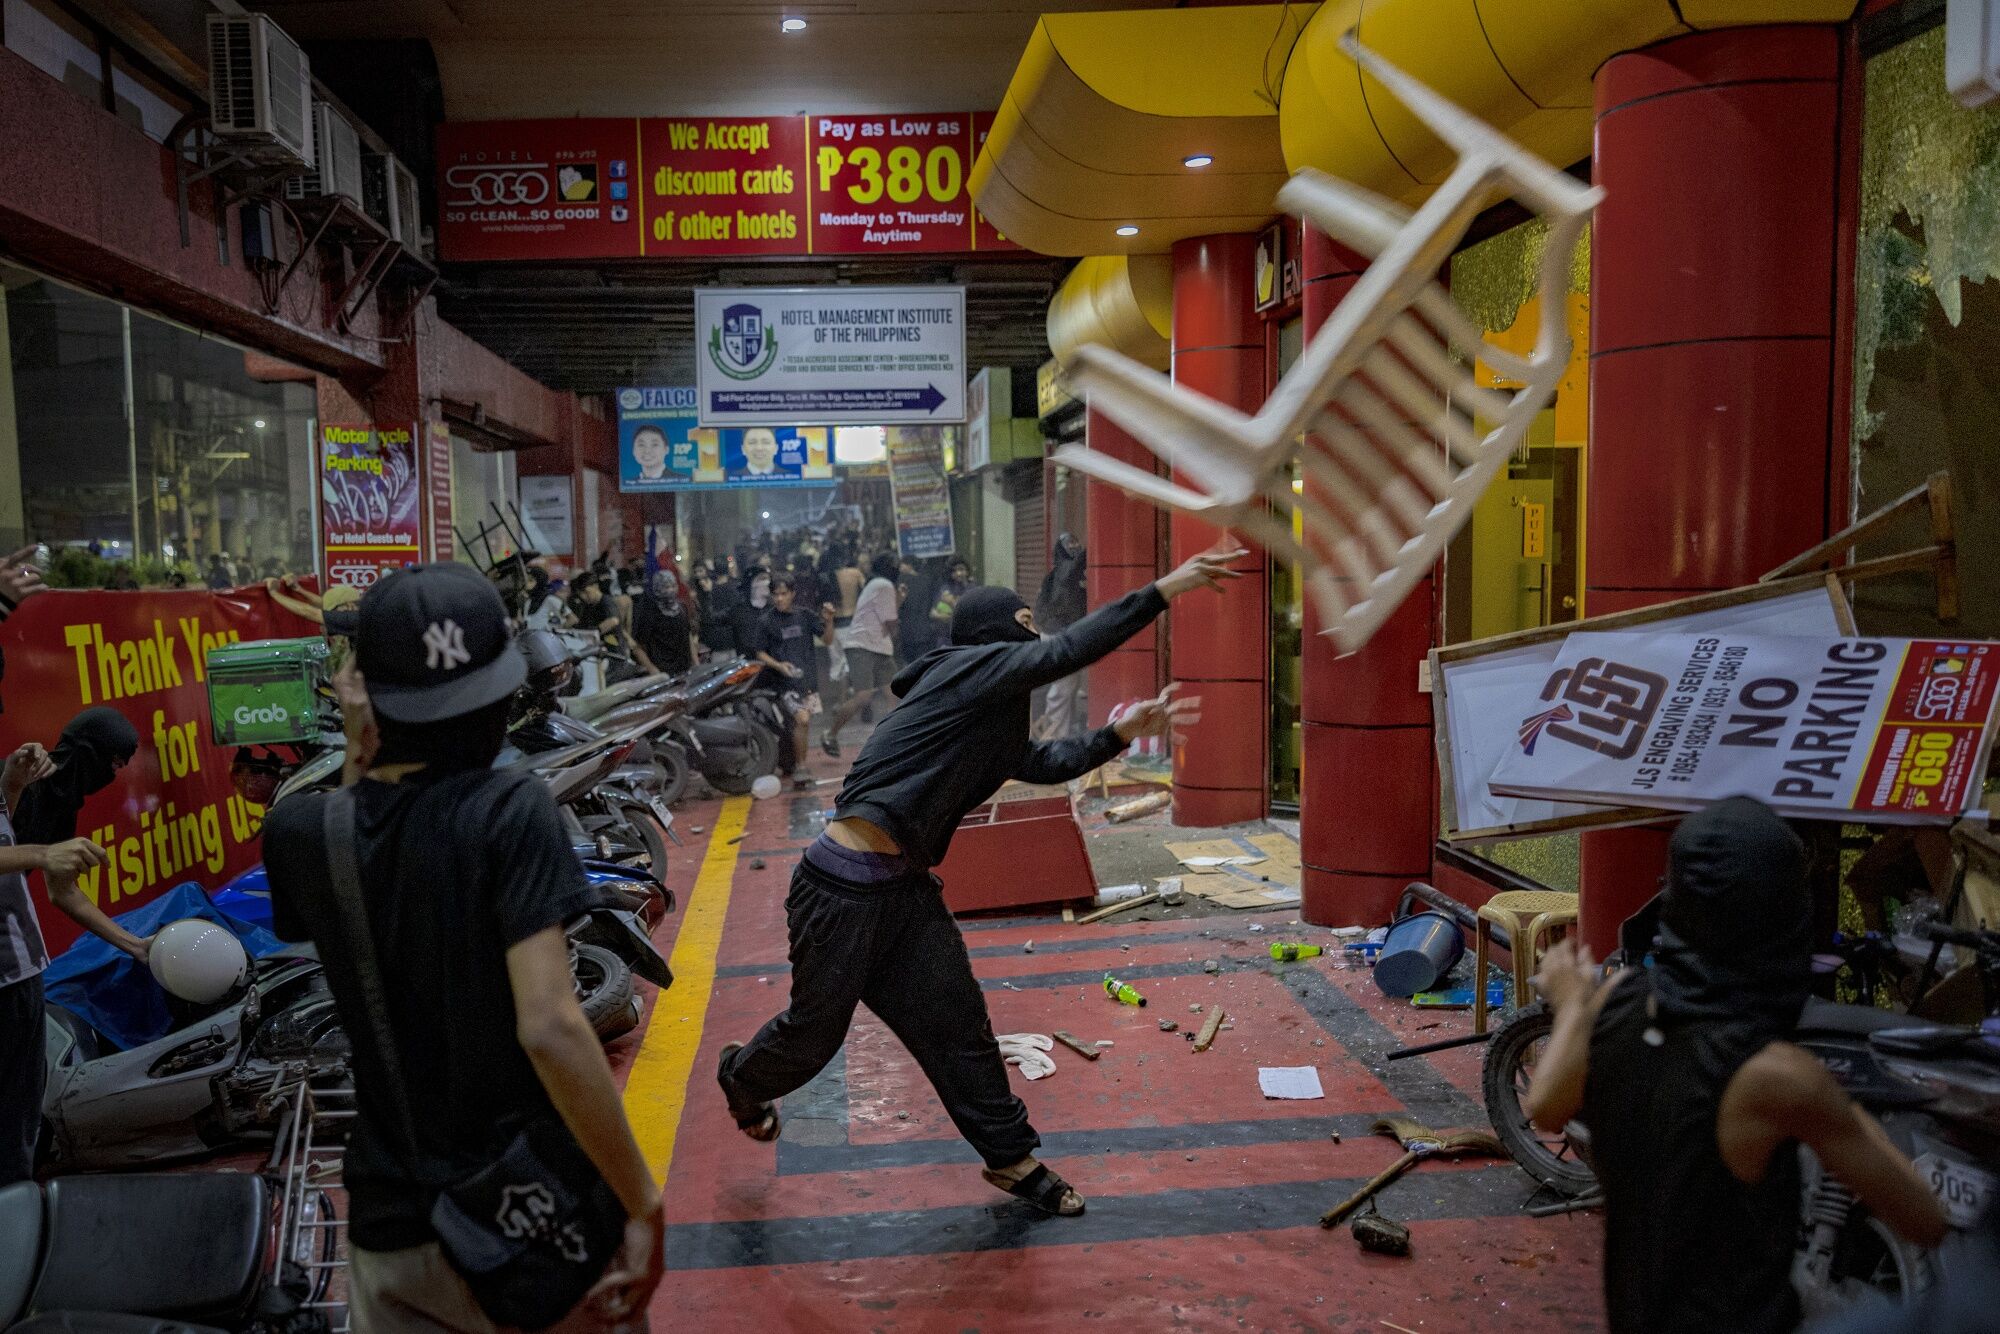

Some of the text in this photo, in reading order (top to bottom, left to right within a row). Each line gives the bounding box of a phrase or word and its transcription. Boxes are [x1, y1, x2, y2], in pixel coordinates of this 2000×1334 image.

[668, 121, 770, 155] We Accept
[819, 118, 960, 141] Pay as Low as
[459, 152, 533, 162] HOTEL
[446, 163, 550, 206] SOGO
[654, 164, 794, 196] discount cards
[446, 211, 466, 222] SO
[554, 208, 600, 220] GOOD!
[653, 208, 797, 241] of other hotels
[819, 211, 964, 228] Monday to Thursday
[863, 229, 922, 245] Anytime
[781, 308, 953, 326] HOTEL MANAGEMENT INSTITUTE
[814, 326, 921, 344] OF THE PHILIPPINES
[645, 389, 697, 407] FALCO
[325, 427, 409, 448] Motorycle
[673, 443, 693, 456] TOP
[782, 439, 802, 452] TOP
[327, 455, 383, 476] Parking
[330, 533, 411, 545] For Hotel Guests only
[1529, 508, 1540, 553] PULL
[64, 618, 183, 705] Thank
[1914, 676, 1960, 721] SOGO
[234, 702, 288, 725] Grab
[1631, 767, 1661, 789] JLS
[1676, 637, 1720, 693] SERVICES
[1718, 677, 1800, 748] NO
[1771, 641, 1888, 800] PARKING
[153, 710, 200, 782] for
[1871, 759, 1901, 807] OVERNIGHT
[1888, 728, 1911, 759] PROMO
[226, 793, 266, 844] us
[1931, 1170, 1977, 1207] 905
